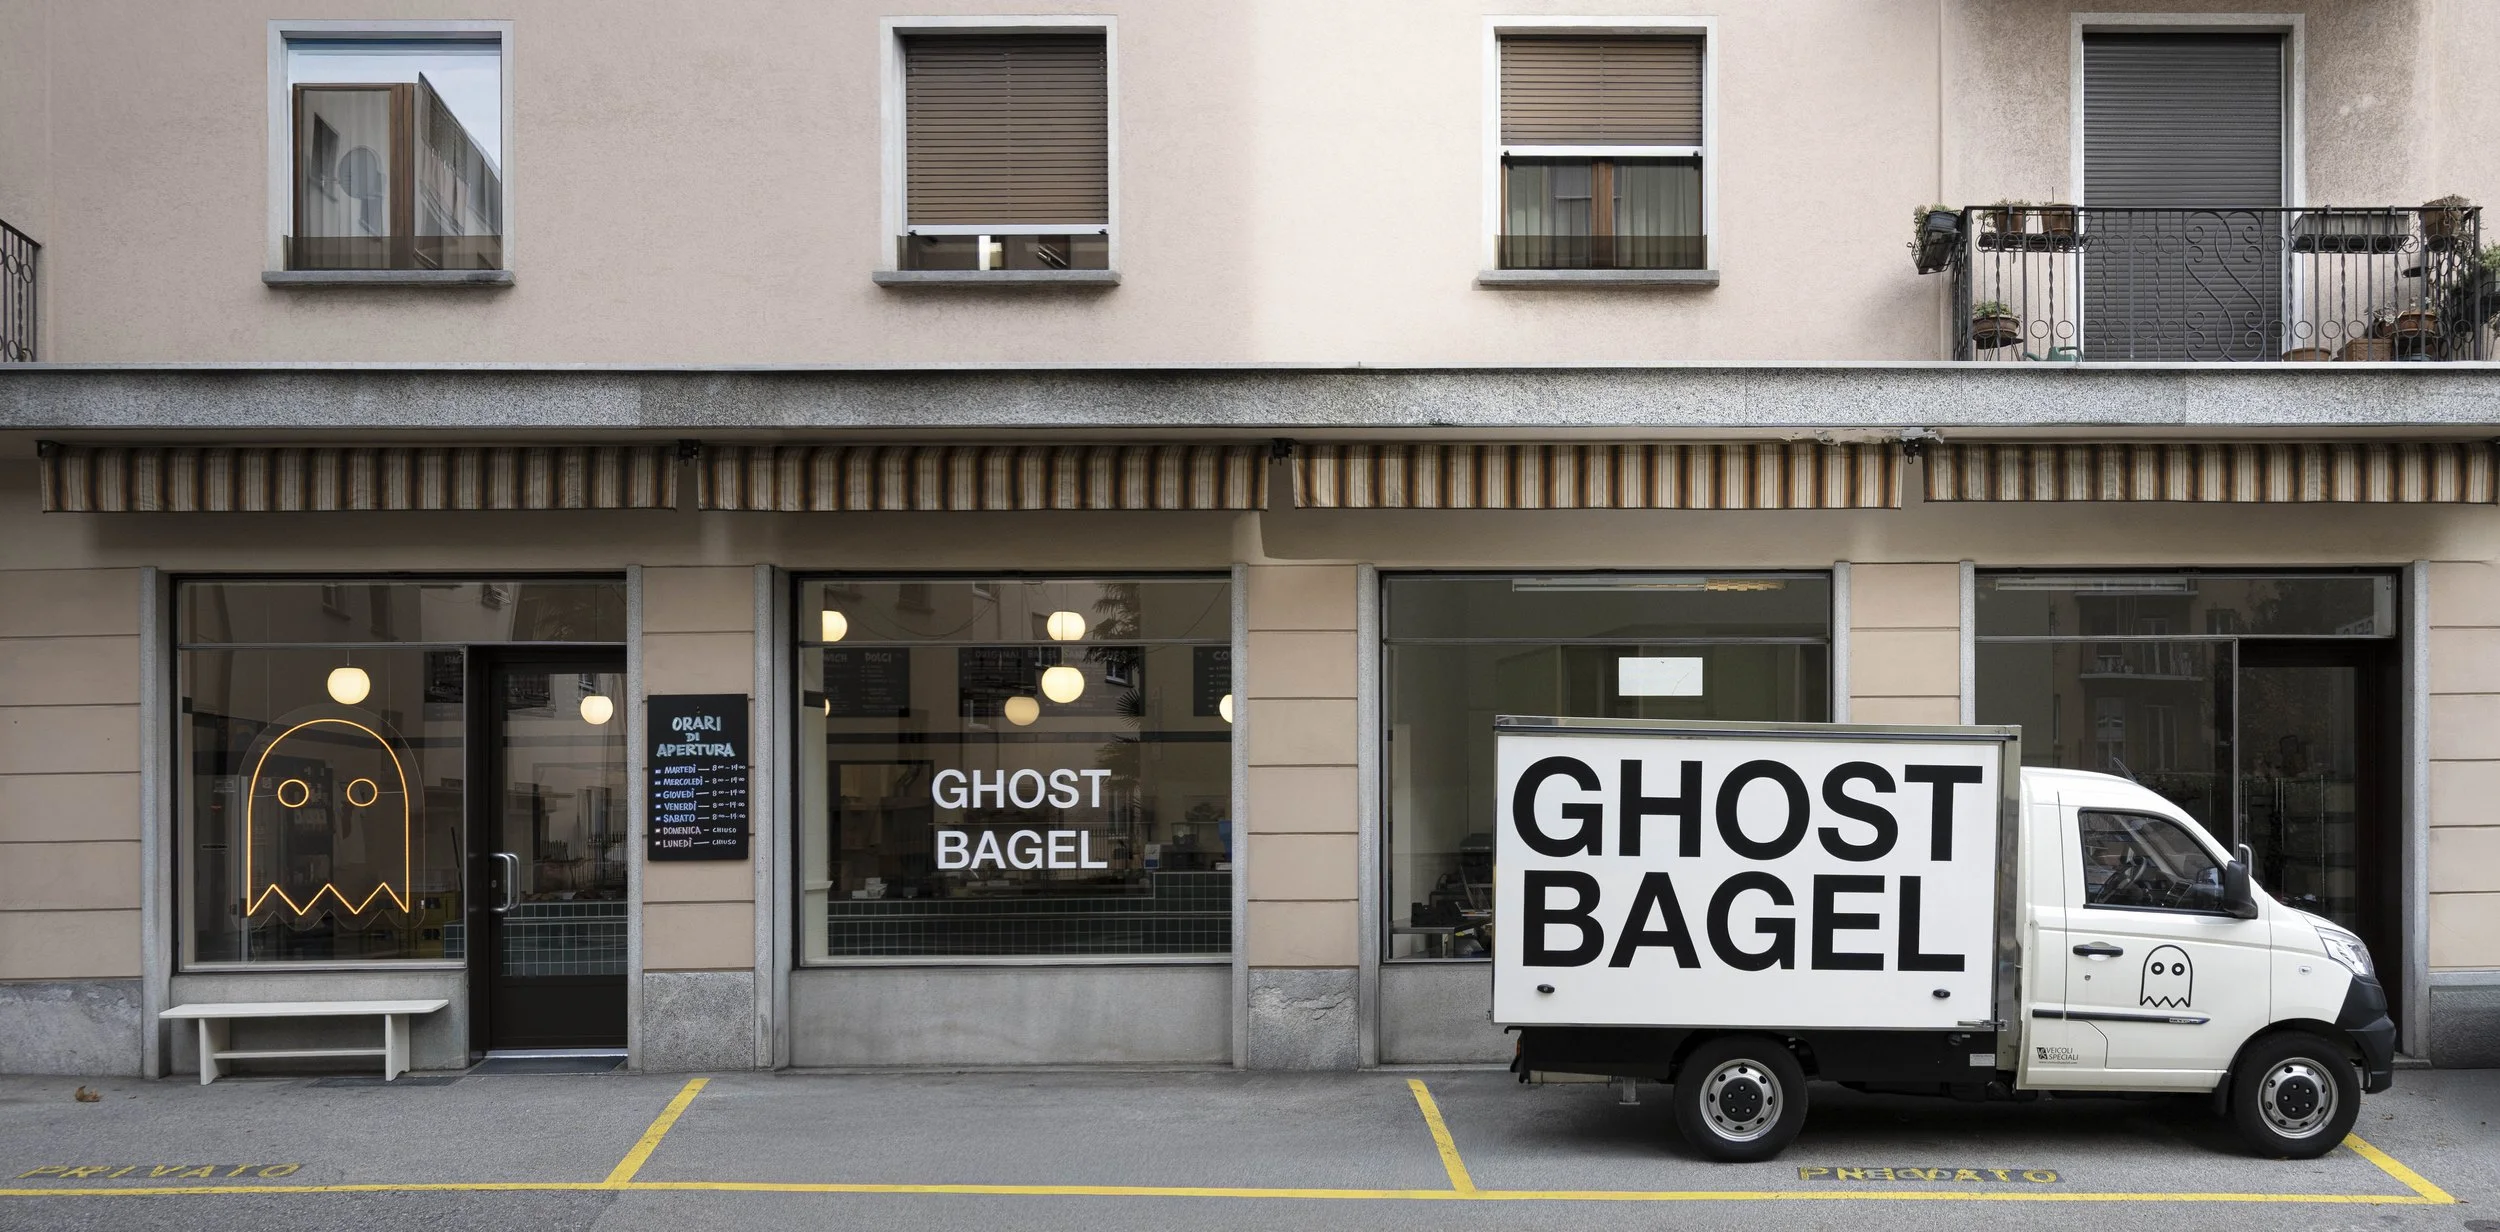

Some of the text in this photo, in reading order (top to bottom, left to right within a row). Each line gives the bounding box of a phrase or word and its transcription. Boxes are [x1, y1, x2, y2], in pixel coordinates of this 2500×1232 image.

[672, 715, 721, 731] ORARI
[685, 732, 700, 742] DI
[656, 742, 736, 757] APERTURA
[664, 764, 697, 774] MARTEDÌ
[663, 776, 703, 786] MERCOLEDÌ
[663, 788, 695, 799] GIOVEDÌ
[931, 768, 1111, 809] GHOST
[664, 800, 697, 811] VENERDÌ
[1512, 756, 1983, 861] GHOST
[663, 814, 696, 823] SABATO
[663, 826, 701, 835] DOMENICA
[663, 837, 693, 848] LUNEDÌ
[937, 829, 1108, 870] BAGEL
[1522, 870, 1965, 972] BAGEL
[17, 1164, 303, 1179] PRIVATO
